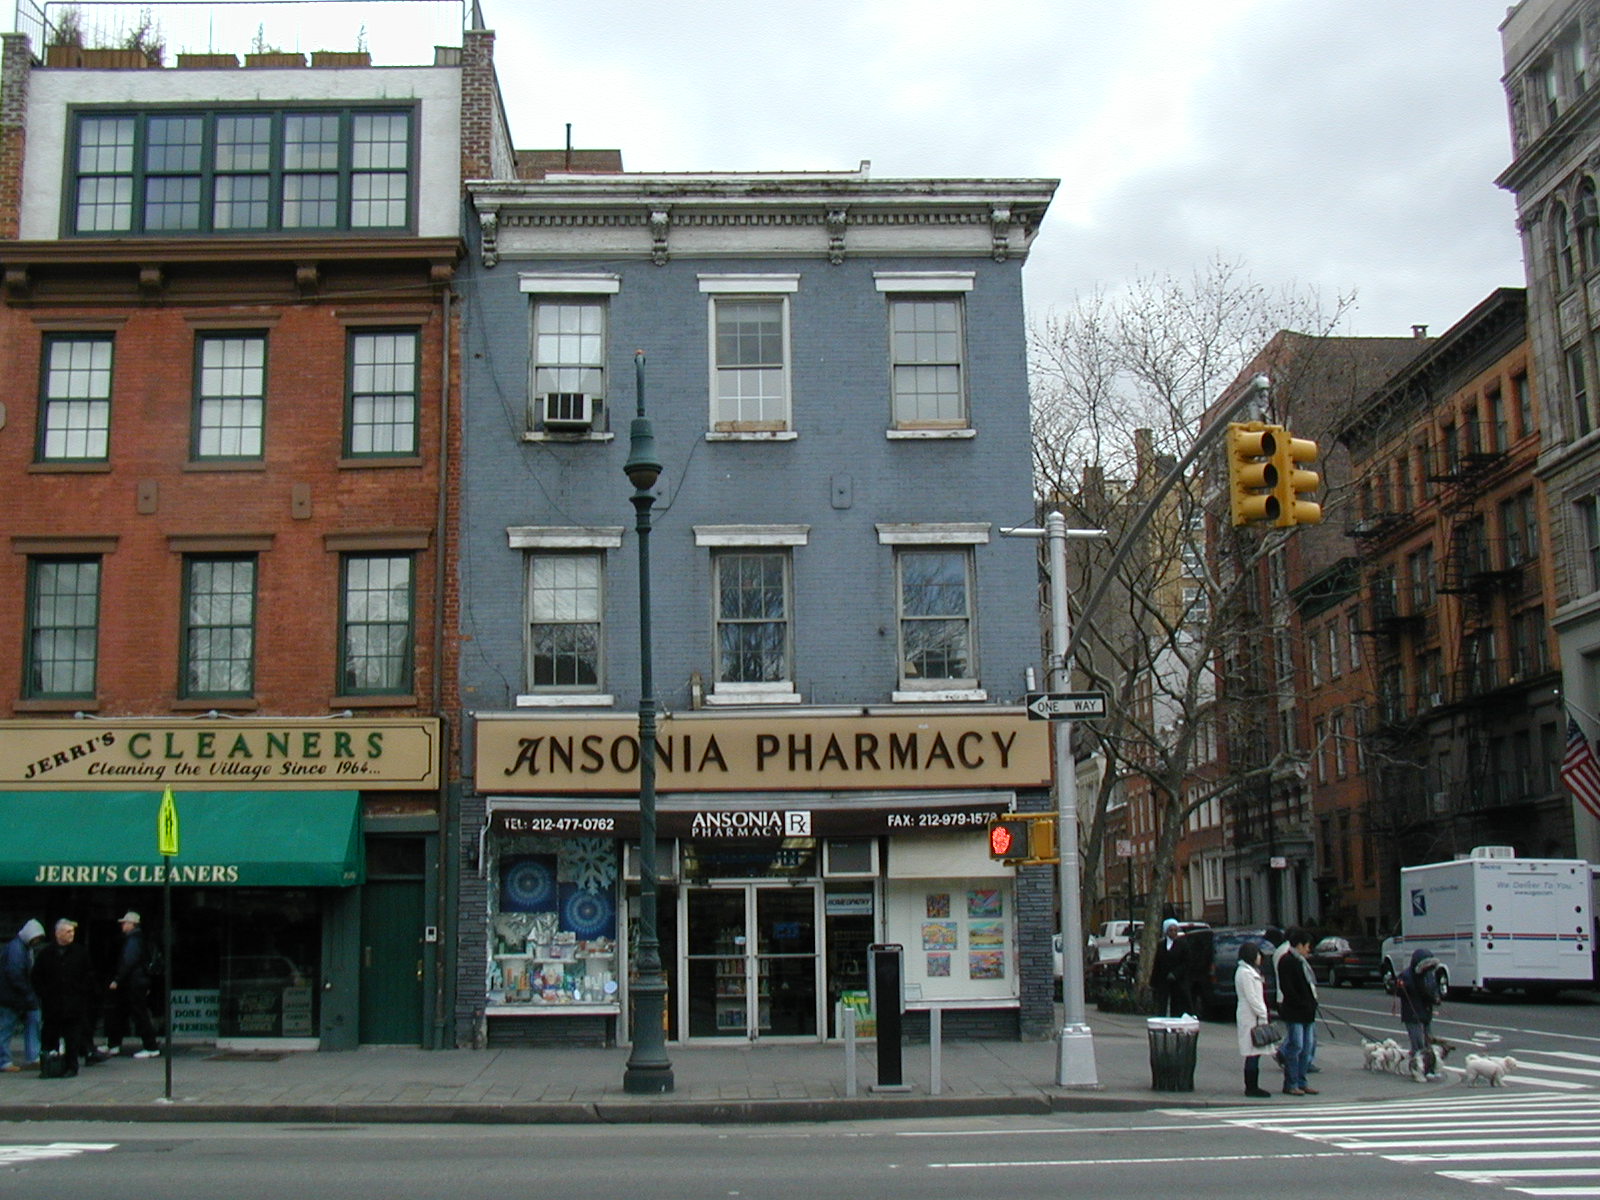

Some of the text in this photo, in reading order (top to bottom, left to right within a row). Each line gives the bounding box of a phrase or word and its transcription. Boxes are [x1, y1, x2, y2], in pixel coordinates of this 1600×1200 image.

[1037, 700, 1097, 712] ONE WAY
[24, 731, 384, 779] JERRI'S CLEANERS
[504, 730, 1017, 776] ANSONIA PHARMACY
[87, 762, 166, 780] Cleaning
[174, 762, 201, 775] the
[209, 761, 272, 781] Village
[279, 761, 327, 775] Since
[504, 817, 615, 831] TEL: 212-477-0762
[692, 811, 782, 828] ANSONIA
[887, 814, 915, 827] FAX:
[691, 826, 783, 838] PHARMACY
[35, 865, 239, 882] JERRI'S CLEANERS
[171, 995, 191, 1004] ALL
[175, 1009, 201, 1018] DONE
